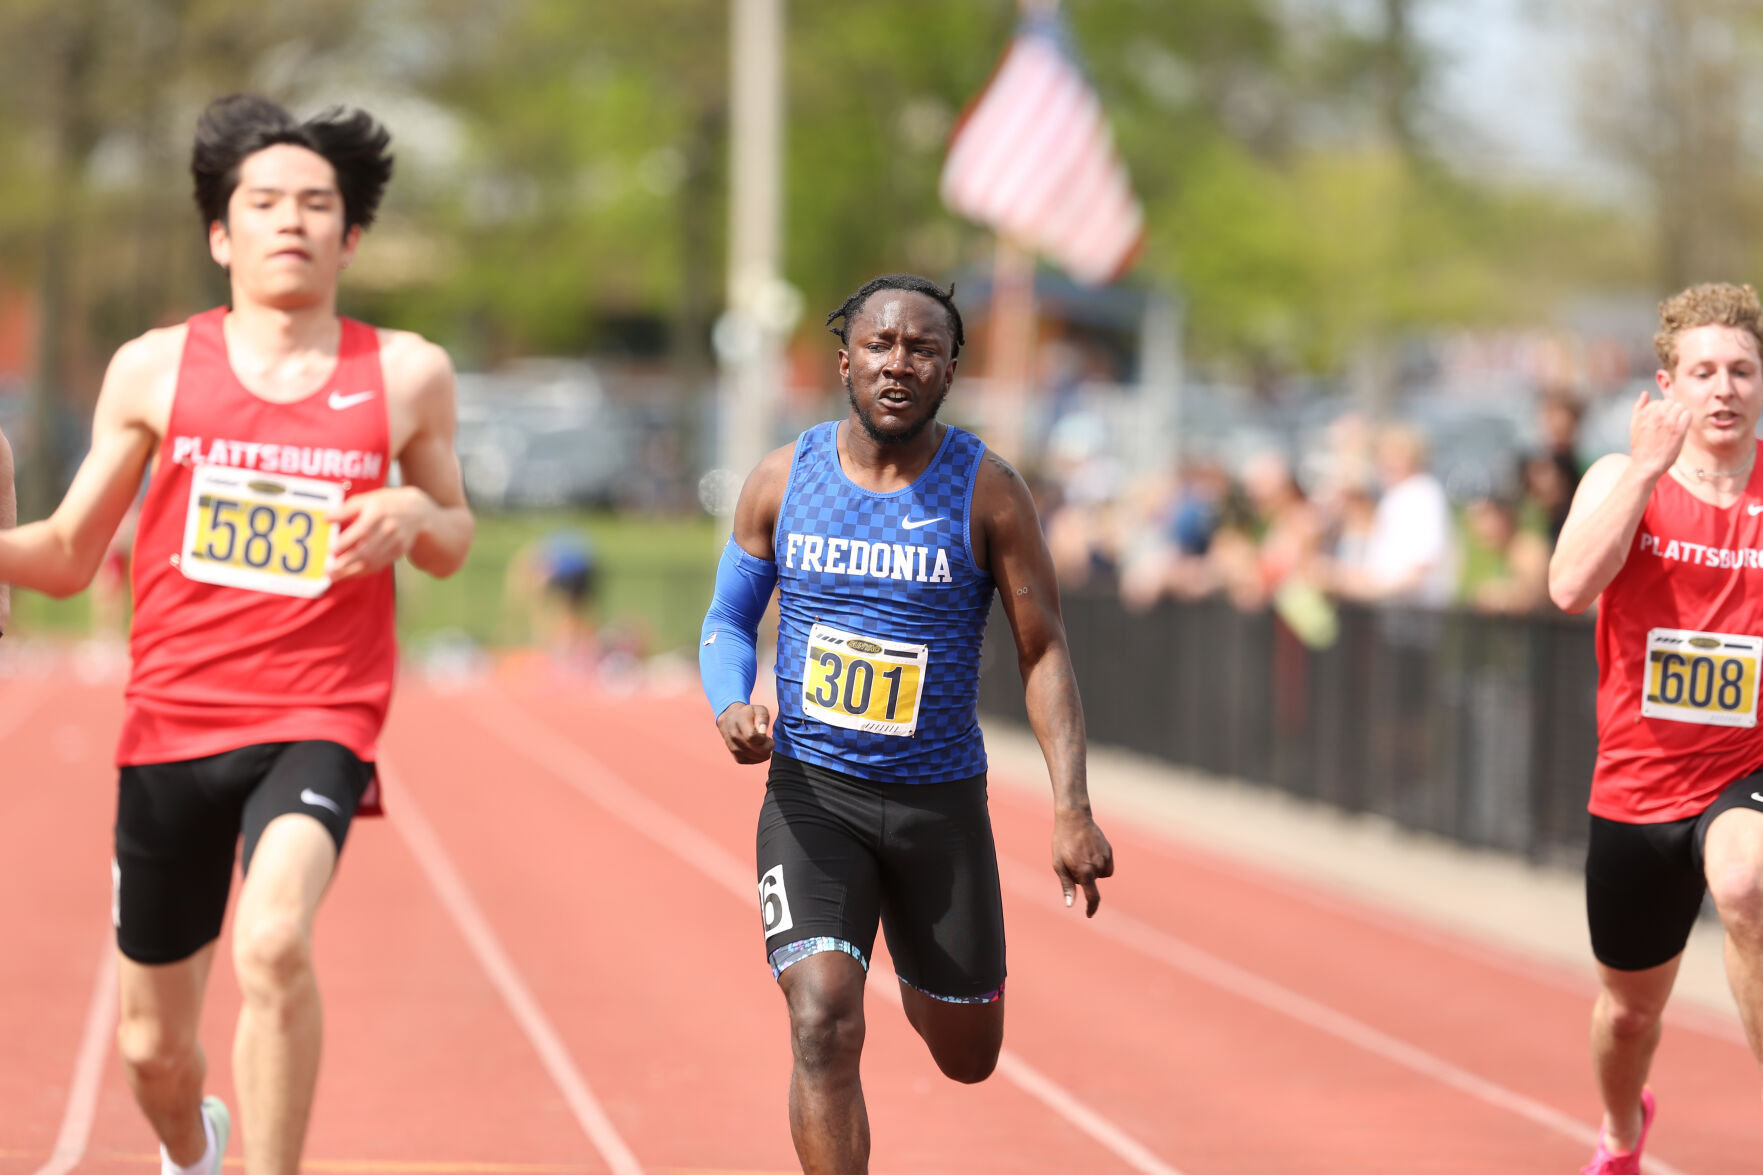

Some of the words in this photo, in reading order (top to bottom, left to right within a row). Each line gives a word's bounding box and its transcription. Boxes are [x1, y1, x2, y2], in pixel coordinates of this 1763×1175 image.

[172, 436, 382, 479] PLATTSBURGH
[206, 500, 313, 574] 583
[786, 533, 953, 583] FREDONIA
[815, 652, 903, 720] 301
[1660, 653, 1744, 711] 608
[763, 875, 782, 932] 6
